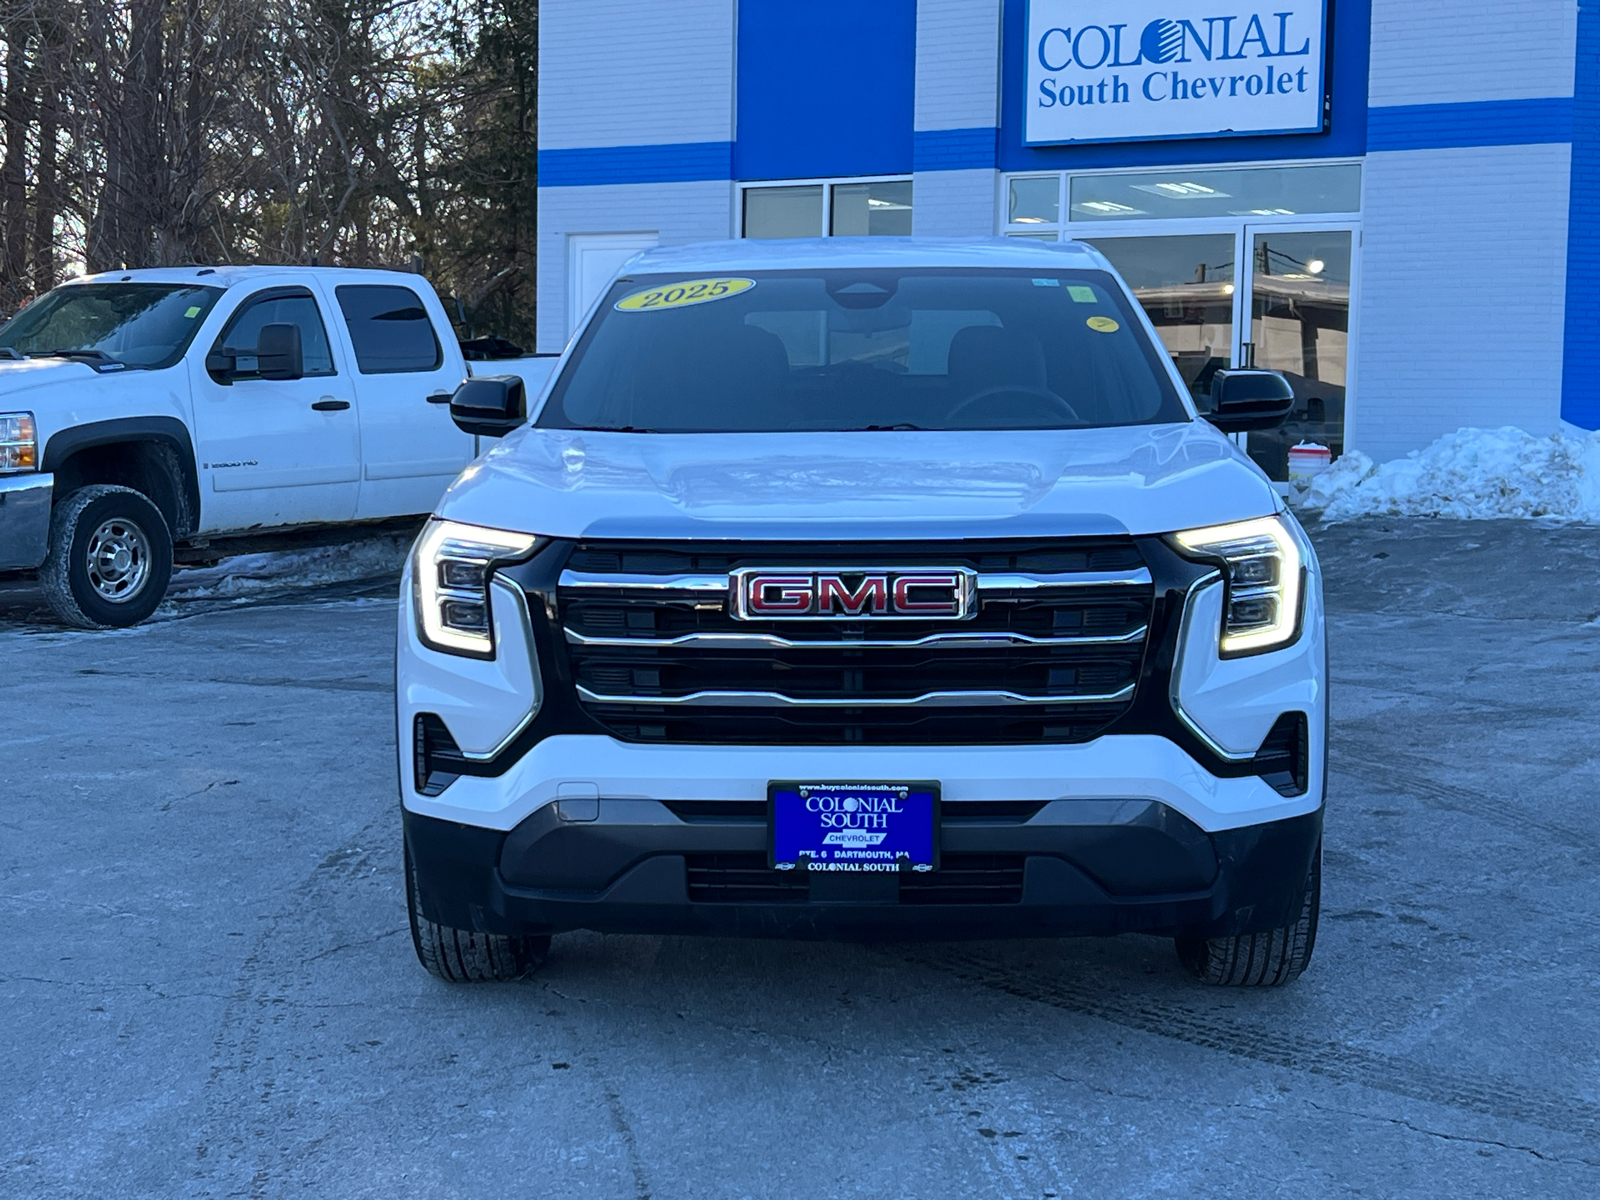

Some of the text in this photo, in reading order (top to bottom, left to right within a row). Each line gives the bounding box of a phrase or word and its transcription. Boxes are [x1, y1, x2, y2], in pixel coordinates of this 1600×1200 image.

[1038, 12, 1310, 71] COLONIAL
[1038, 65, 1309, 108] South Chevrolet
[640, 281, 732, 308] 2025
[750, 576, 957, 614] GMC
[805, 797, 904, 813] COLONIAL
[820, 813, 888, 828] SOUTH
[807, 863, 900, 871] COLONIAL SOUTH
